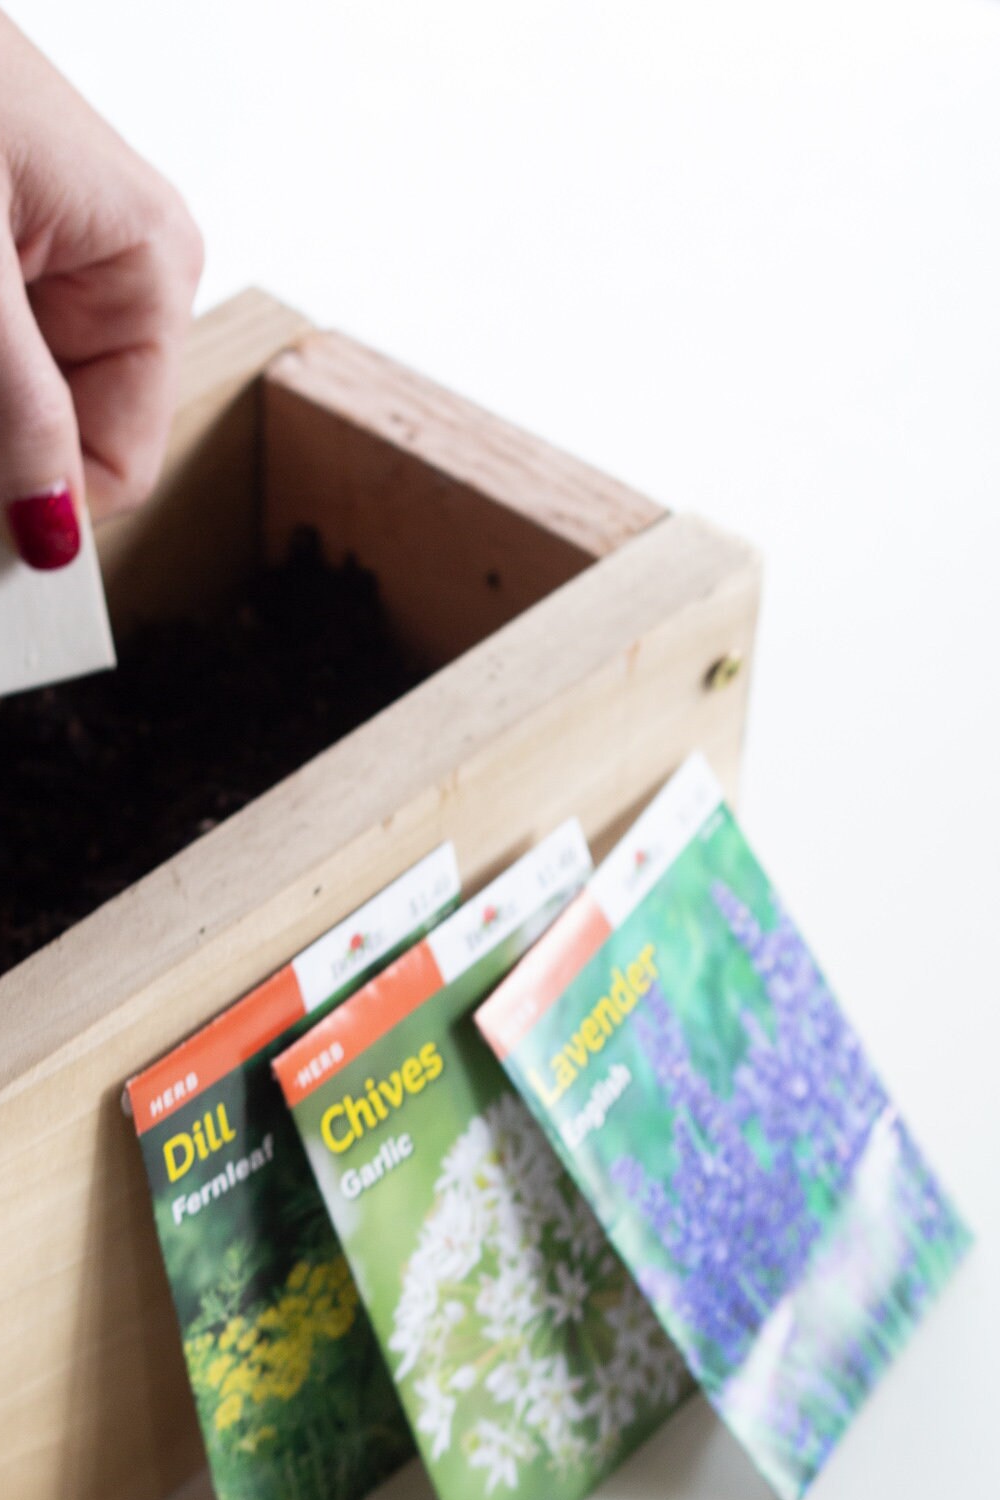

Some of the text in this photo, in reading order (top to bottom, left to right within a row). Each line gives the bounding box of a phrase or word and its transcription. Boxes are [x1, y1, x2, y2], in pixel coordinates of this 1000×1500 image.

[525, 943, 658, 1108] Lavender
[150, 1071, 199, 1118] HERB
[320, 1042, 443, 1154] Chives
[163, 1102, 237, 1183] Dill
[172, 1132, 274, 1226] Fernleaf
[340, 1132, 414, 1200] Garlic
